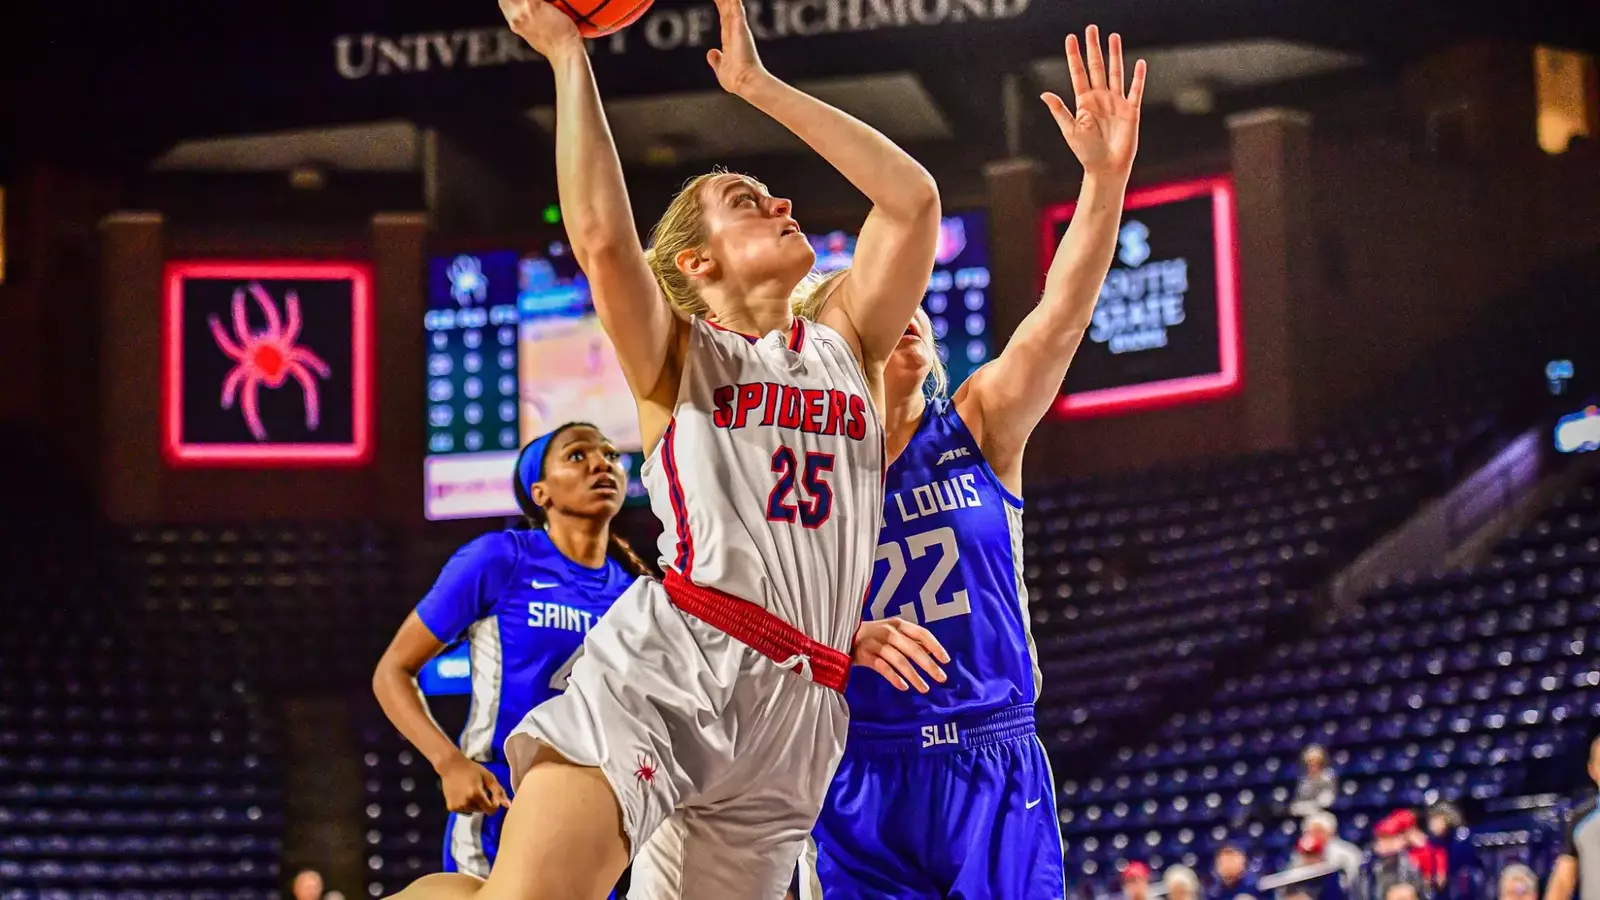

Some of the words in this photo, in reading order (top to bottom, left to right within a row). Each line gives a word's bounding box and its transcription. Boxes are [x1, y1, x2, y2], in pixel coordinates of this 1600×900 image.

[335, 26, 630, 79] UNIVER
[645, 8, 714, 51] OF
[1101, 256, 1188, 301] OUTH
[713, 382, 867, 441] SPIDERS
[766, 445, 835, 529] 25
[894, 473, 982, 523] LOUIS
[871, 526, 971, 624] 22
[528, 601, 592, 633] SAINT
[921, 722, 959, 748] SLU
